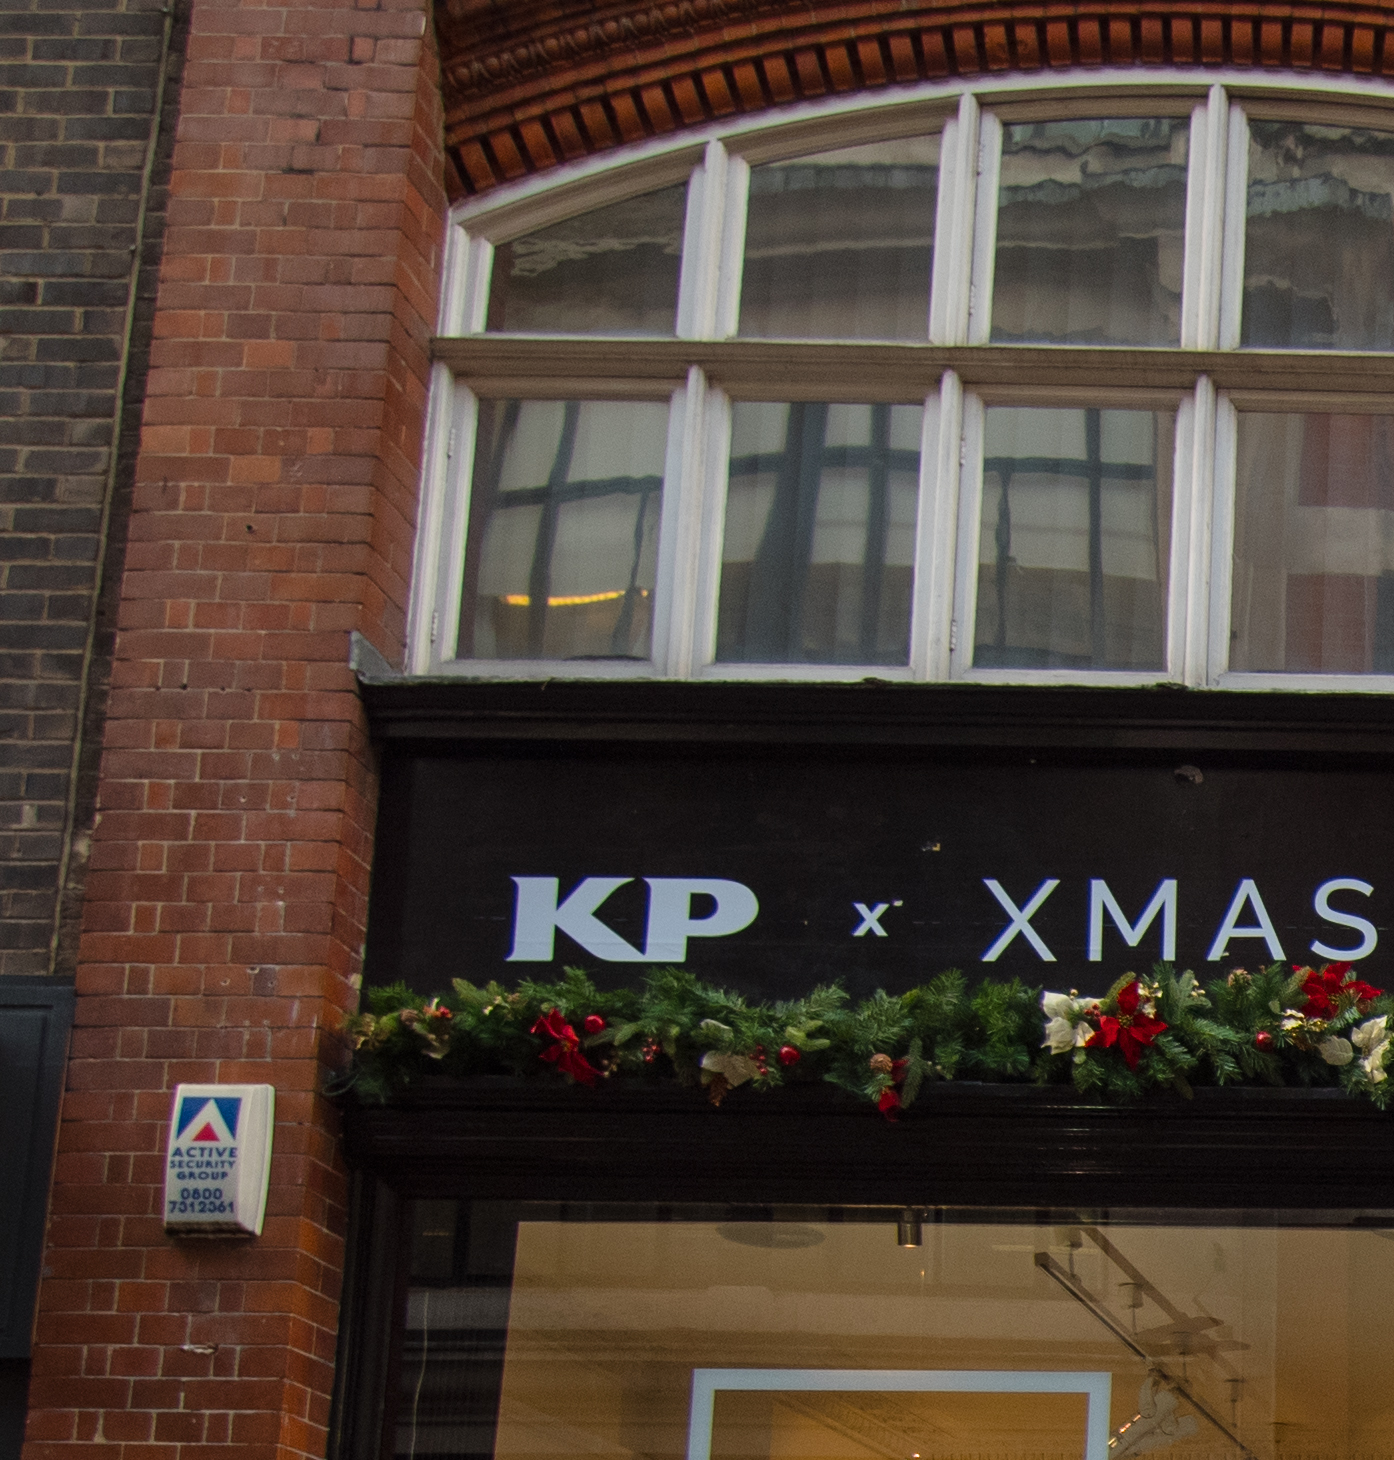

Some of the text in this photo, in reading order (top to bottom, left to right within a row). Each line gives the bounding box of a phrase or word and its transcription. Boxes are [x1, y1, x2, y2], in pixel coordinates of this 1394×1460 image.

[504, 876, 759, 963] KP
[980, 876, 1378, 962] XMAS
[171, 1146, 238, 1158] ACTIVE
[169, 1160, 236, 1169] SECURITY
[176, 1171, 228, 1180] GROUP
[180, 1188, 223, 1200] 0800
[168, 1201, 235, 1213] 7312361
